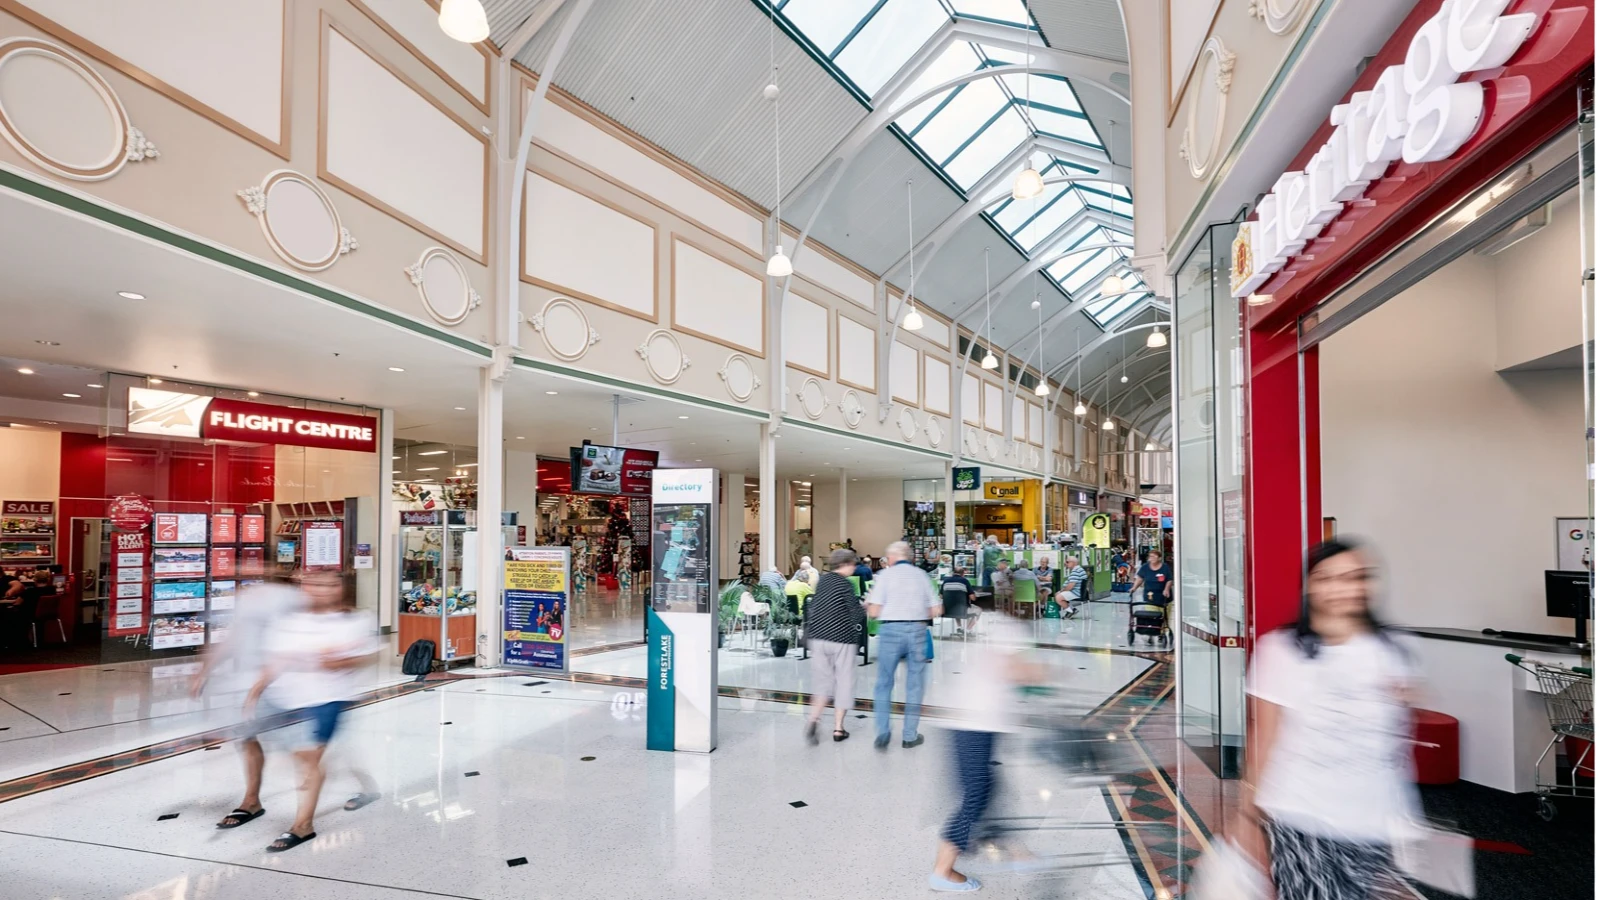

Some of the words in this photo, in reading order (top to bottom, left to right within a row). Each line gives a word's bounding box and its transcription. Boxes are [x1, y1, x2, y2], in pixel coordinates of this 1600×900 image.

[1256, 0, 1537, 274] Heritage
[210, 410, 294, 434] FLIGHT
[295, 419, 373, 441] CENTRE
[661, 483, 702, 492] Directory
[990, 485, 1019, 497] Cignall
[7, 503, 50, 513] SALE
[117, 533, 144, 542] HOT
[551, 628, 562, 638] TV
[660, 635, 668, 690] FORESTLAKE
